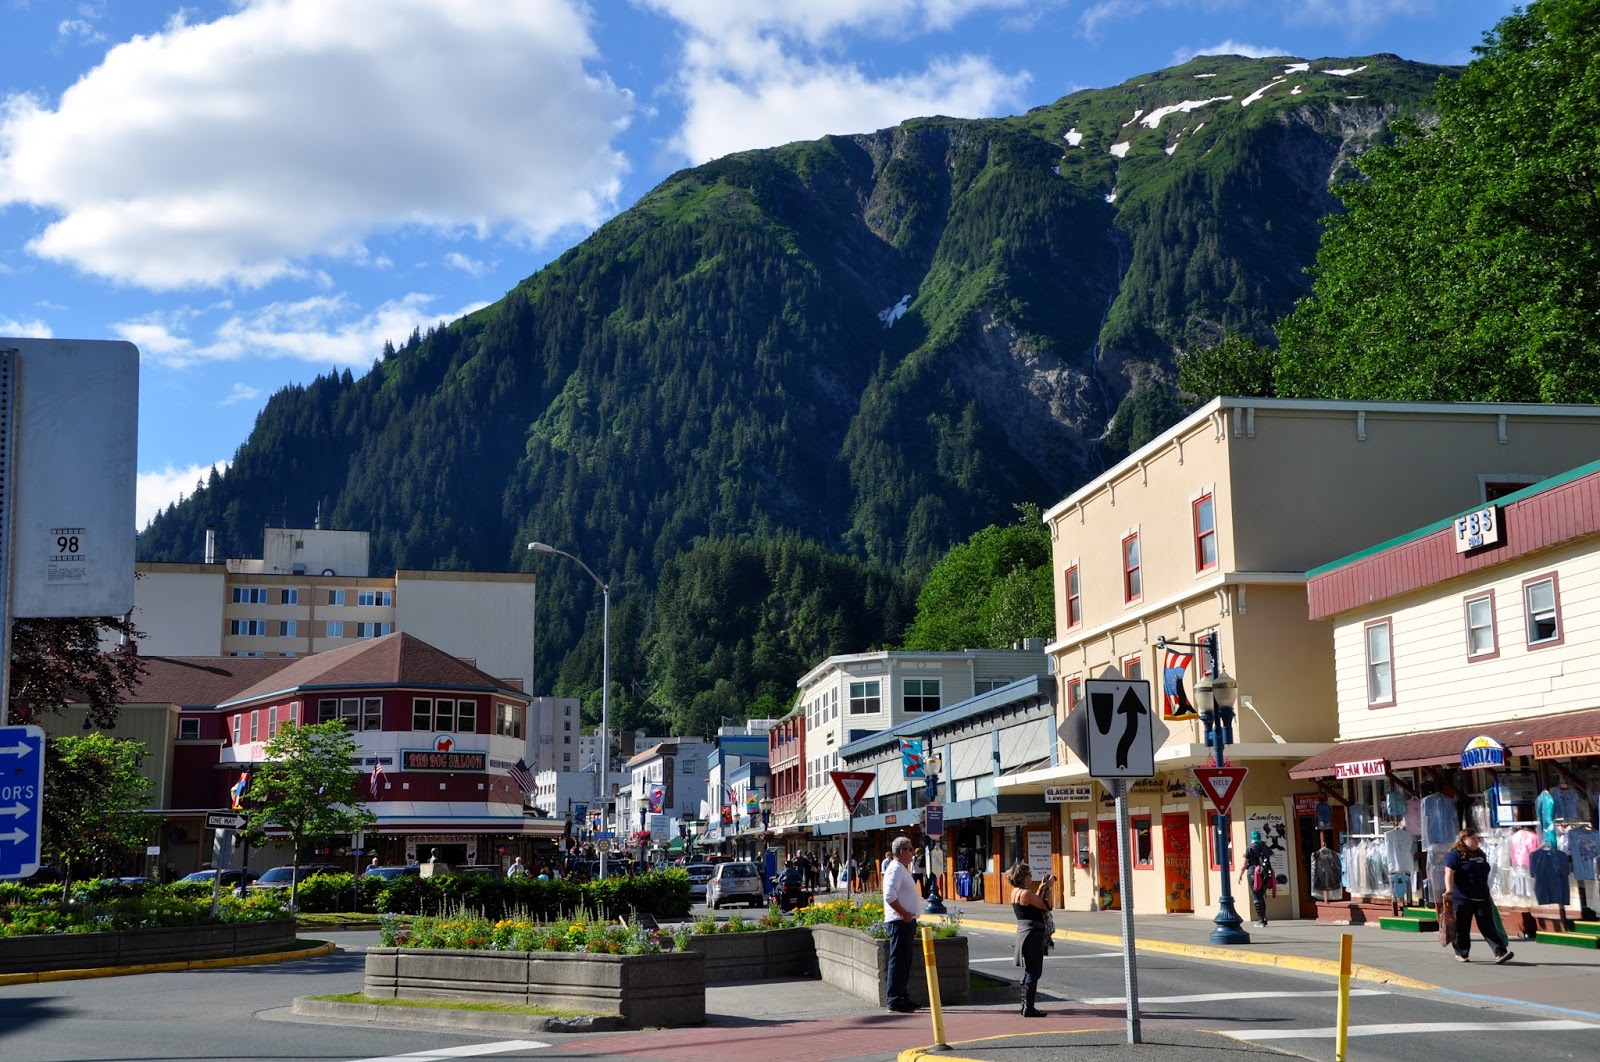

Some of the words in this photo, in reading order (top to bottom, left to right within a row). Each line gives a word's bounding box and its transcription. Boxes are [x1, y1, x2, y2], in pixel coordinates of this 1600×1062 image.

[1458, 508, 1492, 540] FBS
[57, 536, 79, 553] 98
[409, 753, 429, 768] RED
[430, 754, 447, 768] DOG
[448, 755, 483, 769] SALOON
[1461, 747, 1504, 769] HORIZON
[1335, 763, 1360, 778] FIL-AM
[1362, 760, 1385, 775] MART
[1132, 779, 1164, 787] mbros
[210, 816, 222, 824] ONE
[224, 817, 236, 825] WAY
[1248, 813, 1282, 821] Lambros
